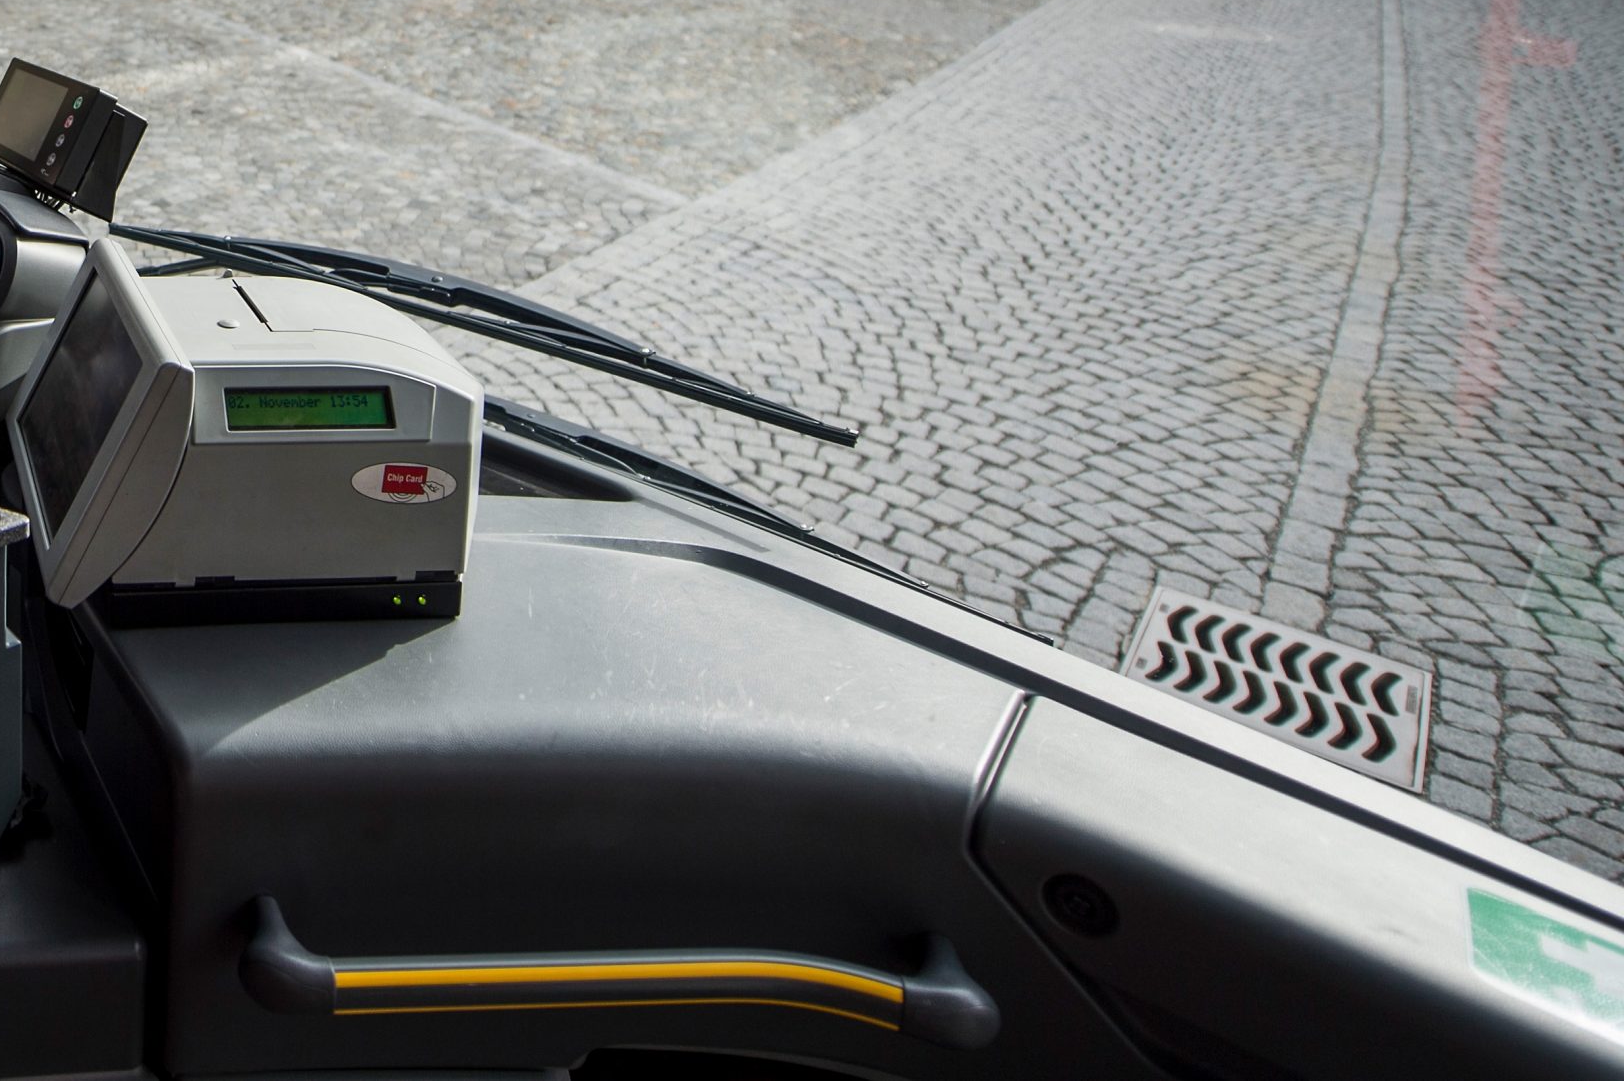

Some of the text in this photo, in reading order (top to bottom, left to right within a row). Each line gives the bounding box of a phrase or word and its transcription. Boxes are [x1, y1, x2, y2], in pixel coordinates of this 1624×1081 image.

[259, 396, 321, 408] November
[330, 394, 368, 408] 13:54
[387, 473, 423, 483] Chip Card
